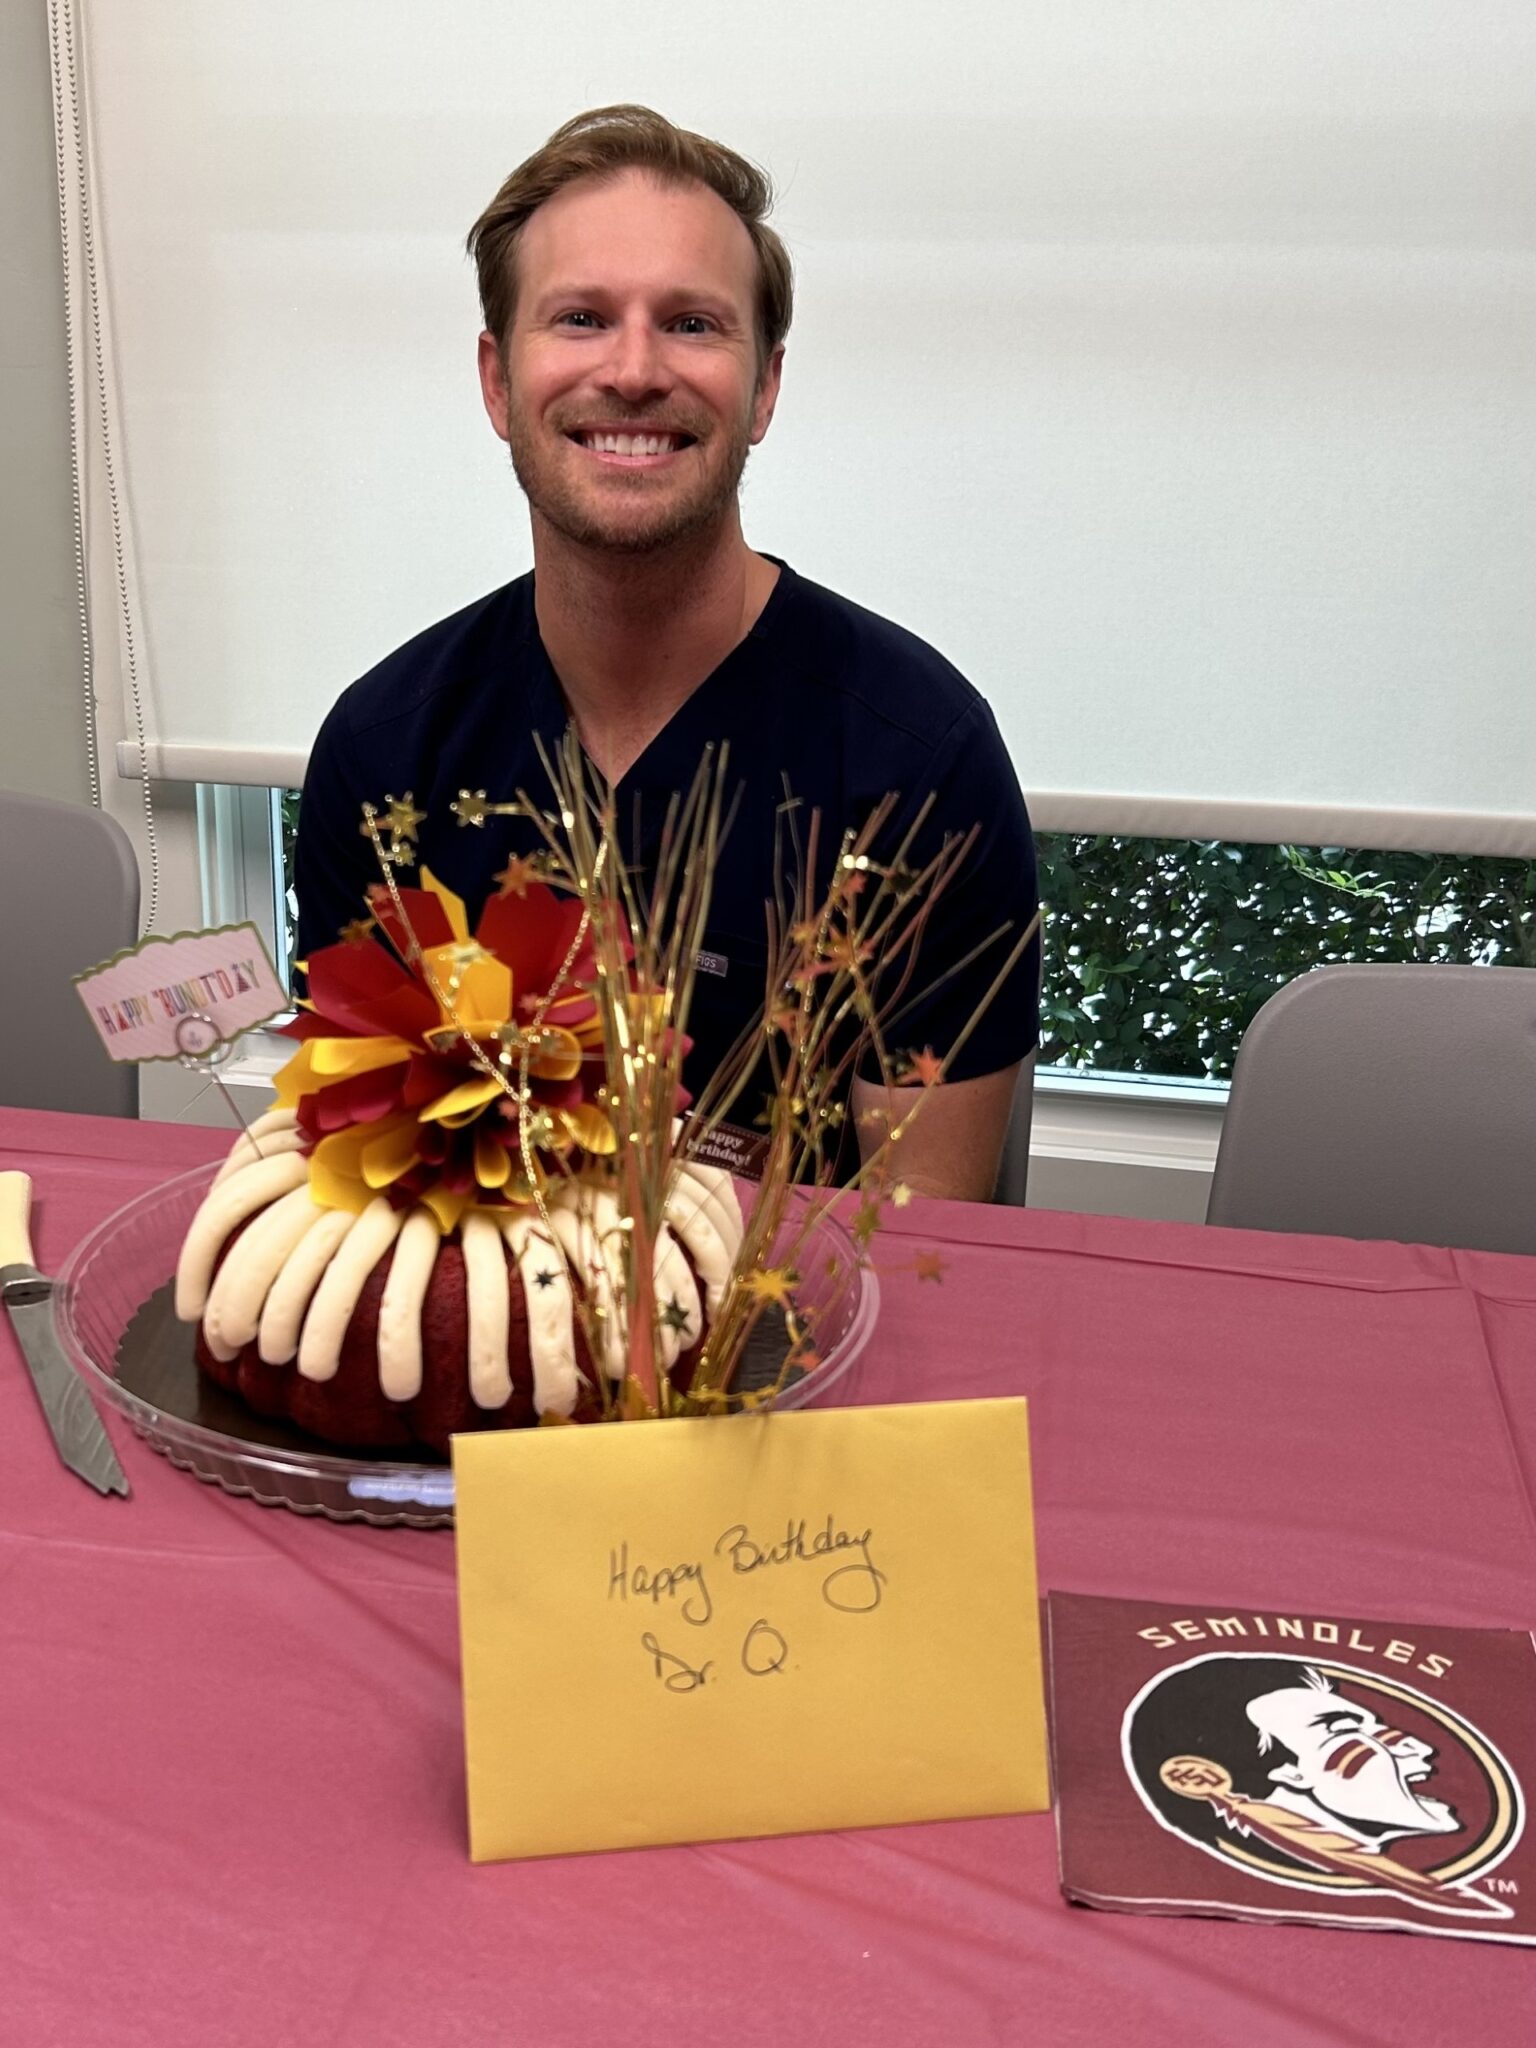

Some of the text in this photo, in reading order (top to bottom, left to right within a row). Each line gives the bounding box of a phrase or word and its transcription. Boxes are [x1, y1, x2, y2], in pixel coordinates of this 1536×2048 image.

[695, 954, 717, 968] FIGS
[96, 995, 155, 1036] HAPPY
[608, 1513, 888, 1626] Happy Birthday
[1136, 1616, 1455, 1680] SEMINOLES
[1482, 1877, 1519, 1894] TM
